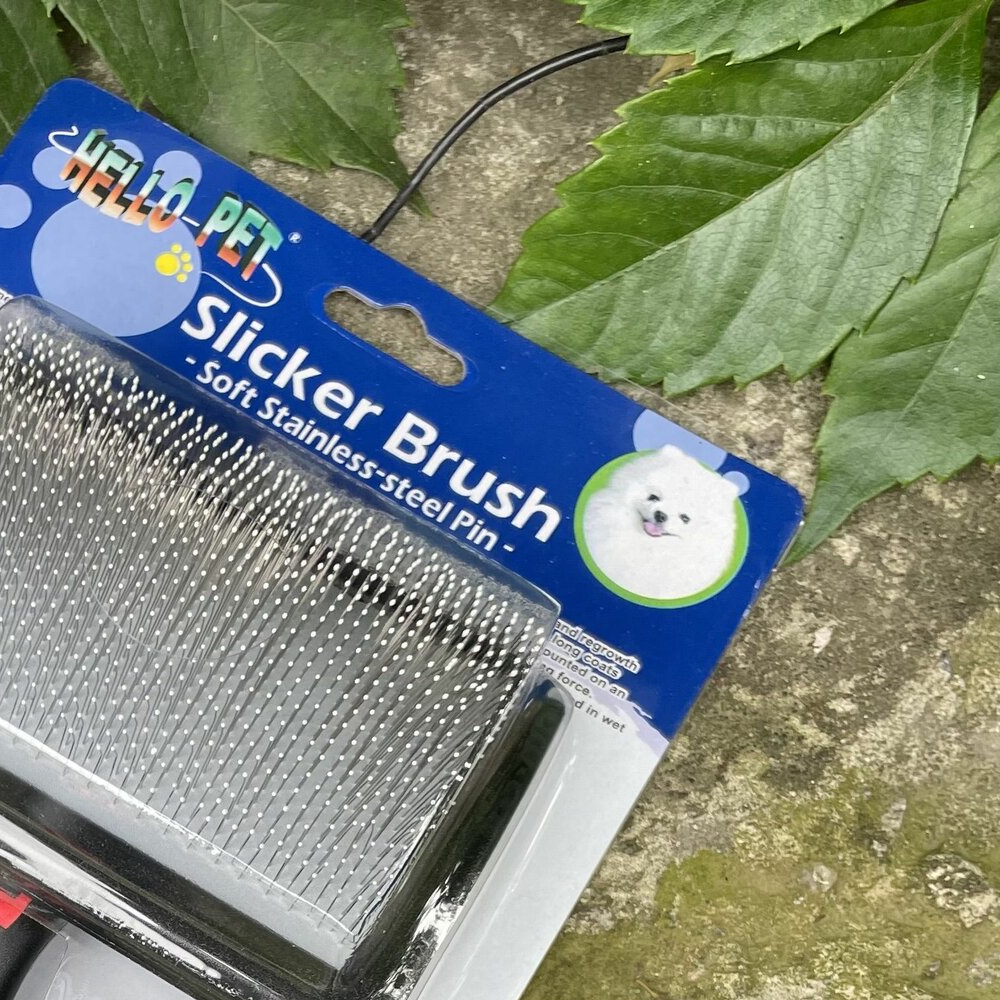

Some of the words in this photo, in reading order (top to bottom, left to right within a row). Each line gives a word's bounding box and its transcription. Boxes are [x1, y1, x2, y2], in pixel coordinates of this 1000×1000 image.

[180, 295, 384, 431] Slicker
[382, 411, 562, 543] Brush
[195, 360, 260, 409] Soft
[256, 396, 454, 523] Stainless-steel
[449, 509, 500, 551] Pin
[552, 634, 581, 658] long
[583, 654, 620, 678] coats
[580, 634, 639, 672] regrowth
[590, 674, 608, 689] on
[609, 685, 627, 699] an
[586, 704, 599, 718] in
[601, 714, 626, 733] wet
